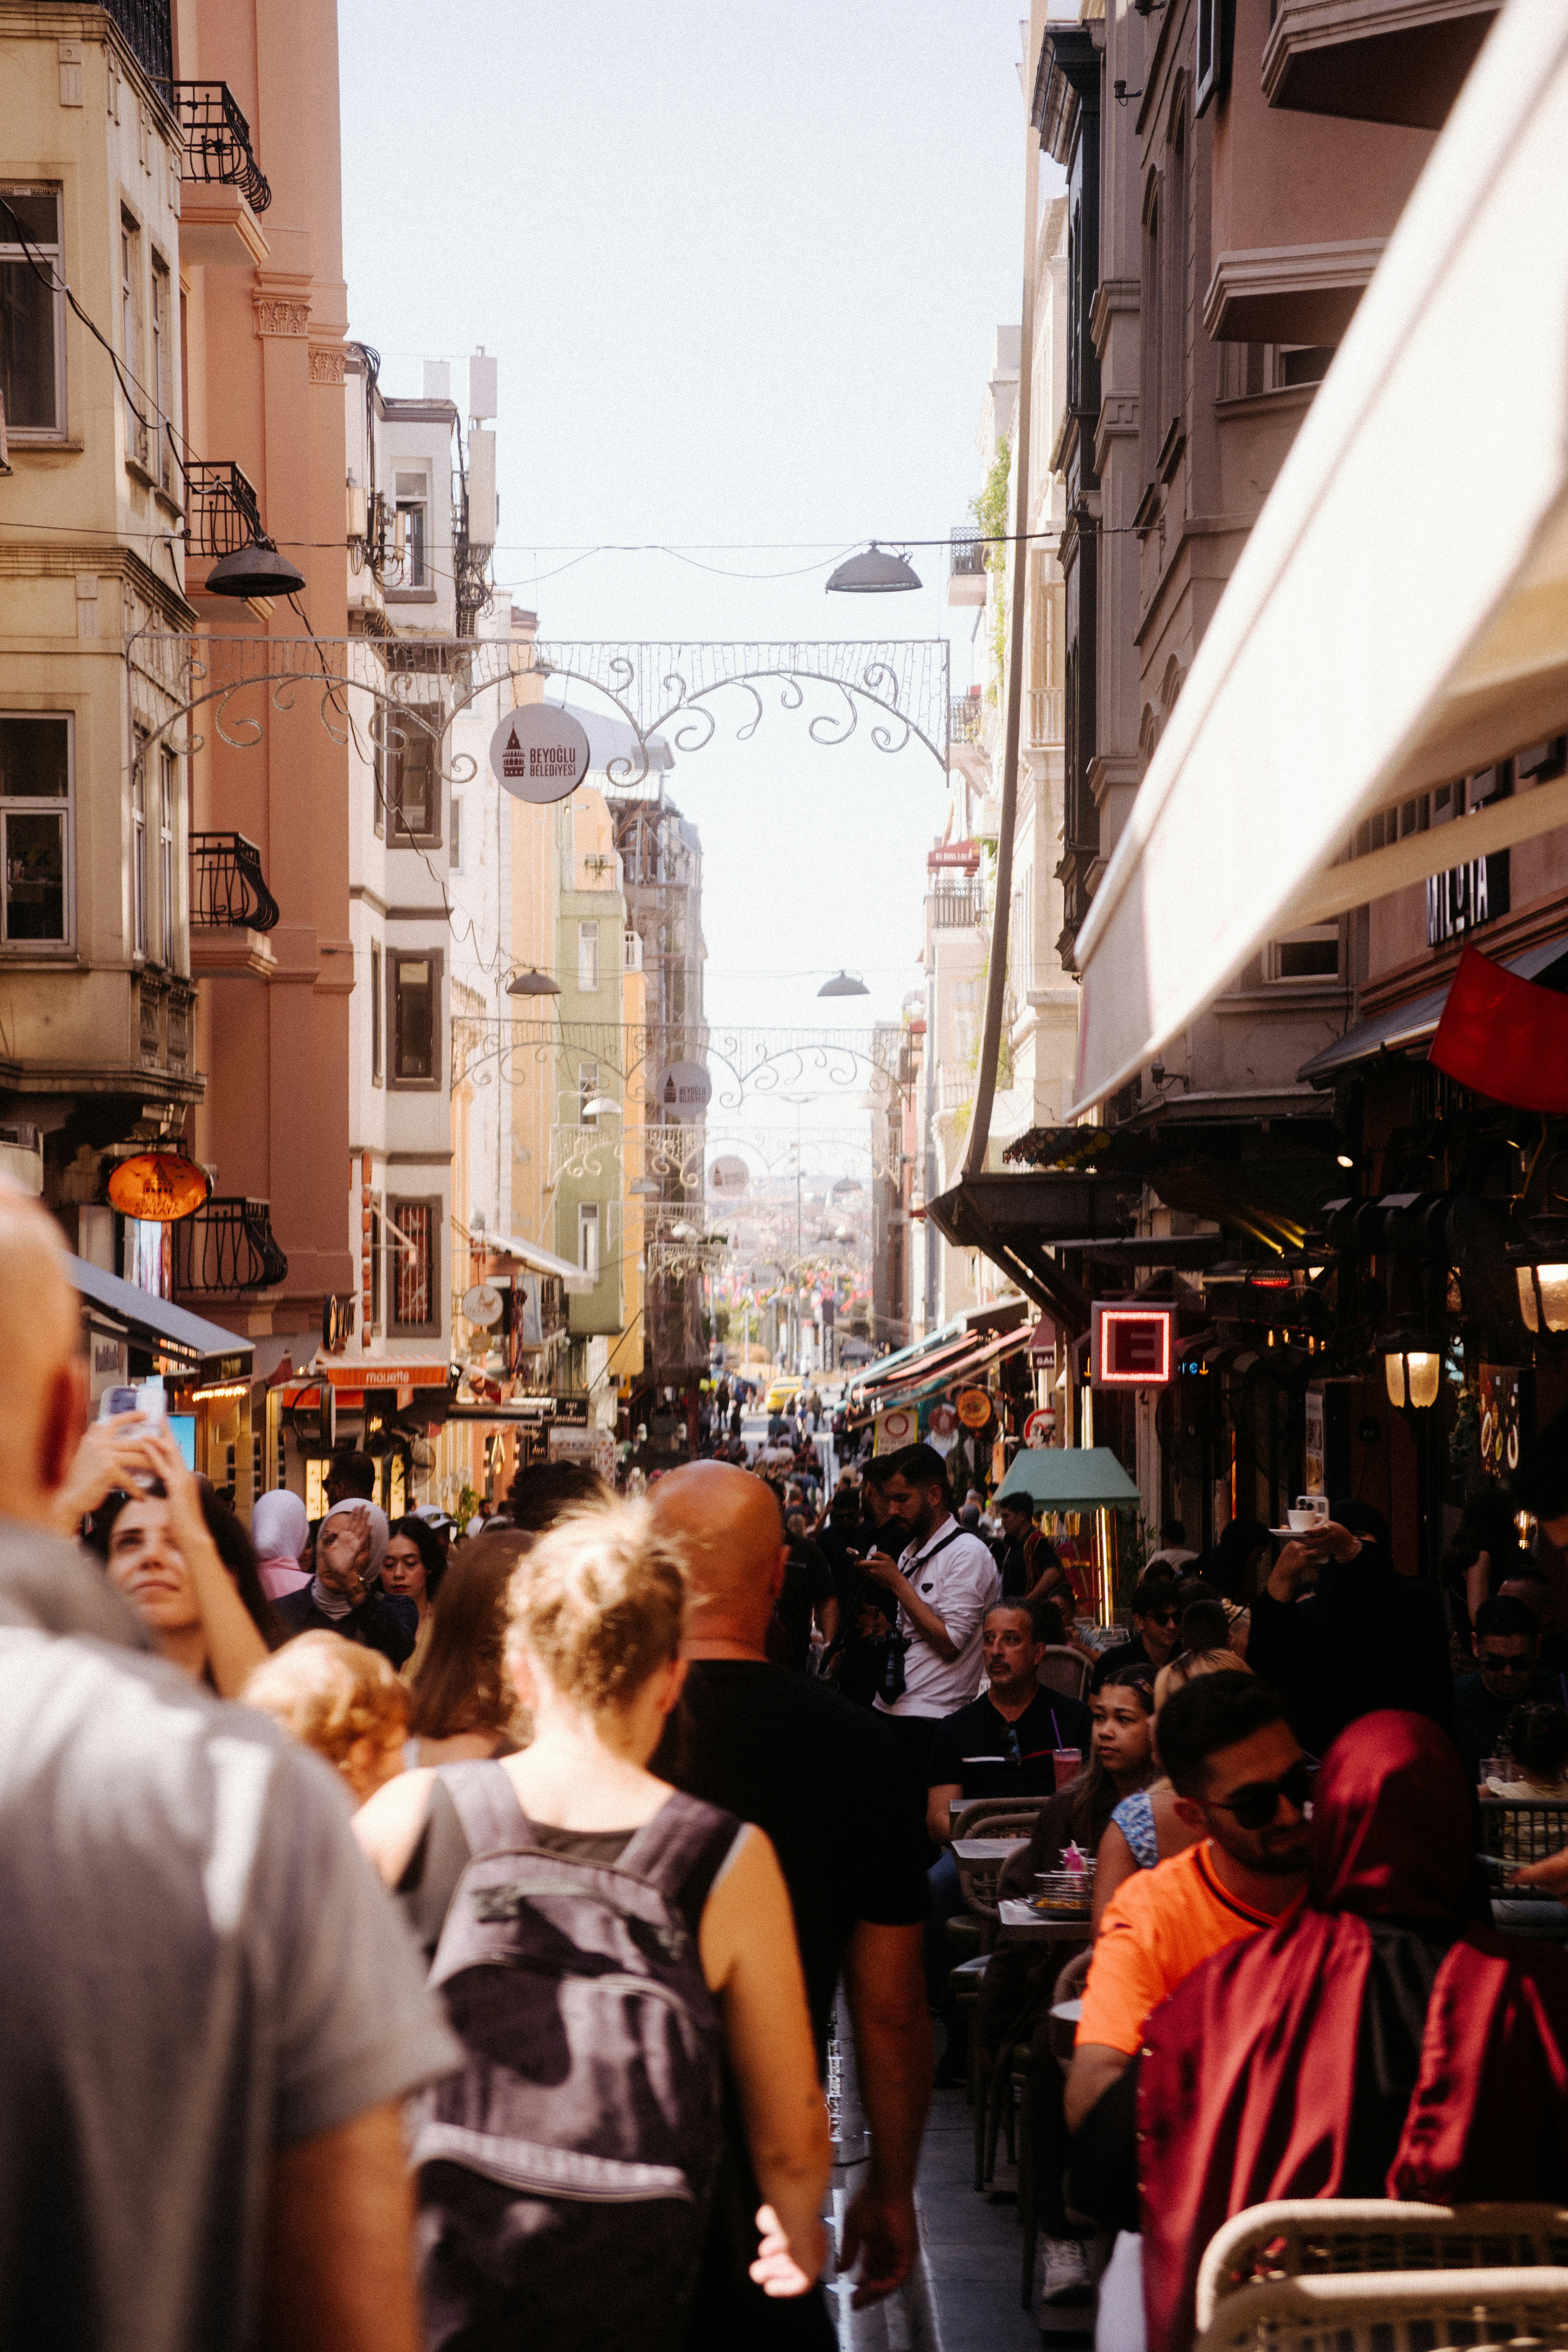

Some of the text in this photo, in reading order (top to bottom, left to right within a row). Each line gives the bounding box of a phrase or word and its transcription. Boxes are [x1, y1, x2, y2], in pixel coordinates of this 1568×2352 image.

[530, 744, 575, 763] BEYOĞLU
[530, 763, 575, 776] BELEDİYESİ
[1115, 1321, 1156, 1371] E
[366, 1369, 409, 1384] mouette
